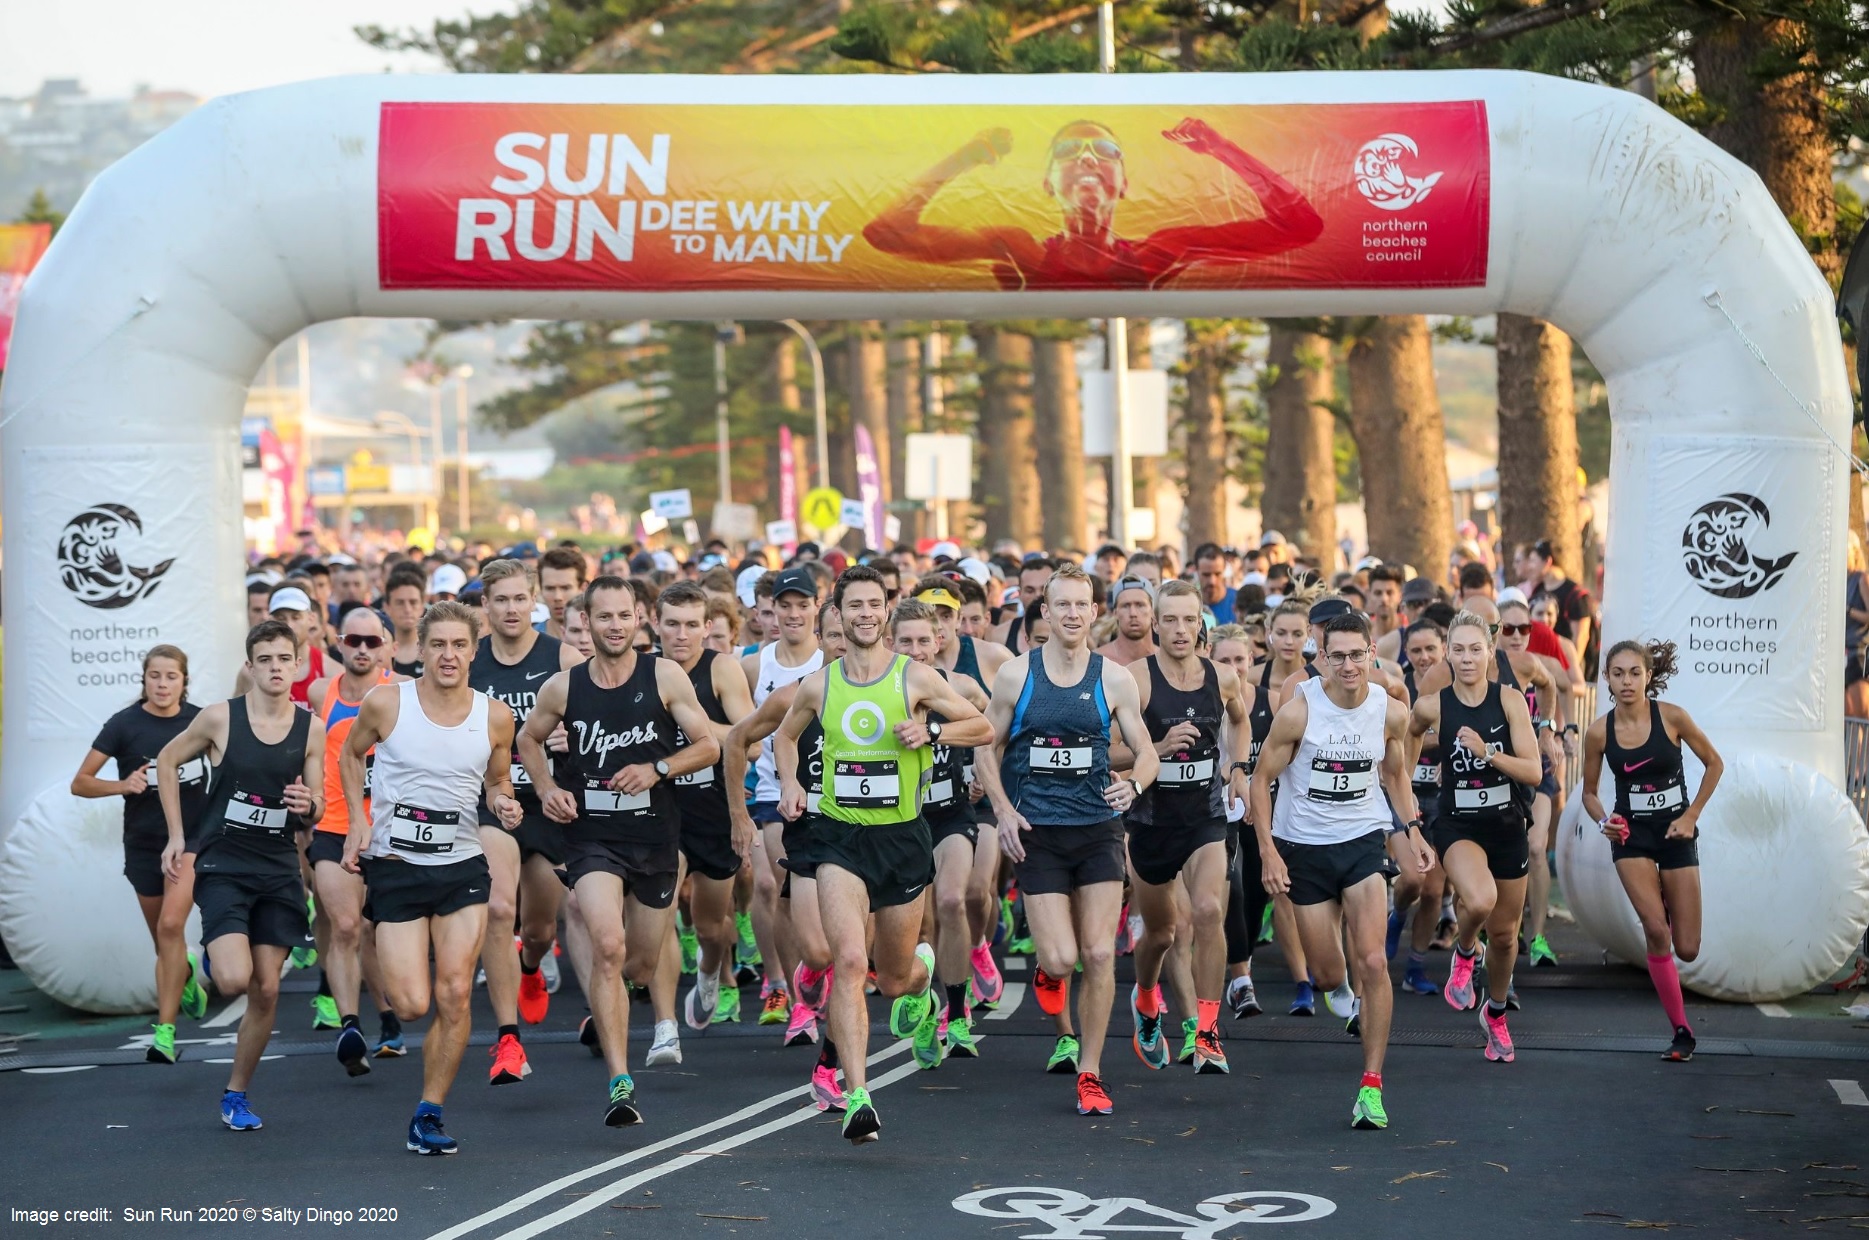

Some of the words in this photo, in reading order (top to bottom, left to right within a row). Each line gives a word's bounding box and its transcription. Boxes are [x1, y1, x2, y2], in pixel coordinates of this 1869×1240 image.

[491, 131, 670, 196] SUN
[640, 201, 716, 231] DEE
[728, 201, 831, 232] WHY
[1362, 218, 1428, 231] northern
[455, 199, 636, 261] RUN
[671, 234, 706, 253] TO
[713, 234, 854, 263] MANLY
[1362, 234, 1427, 247] beaches
[1366, 249, 1422, 261] council
[1690, 612, 1778, 630] northern
[70, 623, 159, 640] northern
[1689, 633, 1777, 653] beaches
[71, 646, 147, 664] beache
[1694, 658, 1770, 675] council
[77, 672, 142, 686] counc
[572, 720, 658, 768] Vipers
[1329, 734, 1363, 745] L.A.D.
[1050, 750, 1071, 767] 43
[1179, 764, 1195, 780] 10
[1419, 767, 1436, 781] 35
[860, 778, 870, 796] 6
[1333, 775, 1349, 790] 13
[611, 792, 621, 809] 7
[1478, 790, 1488, 806] 9
[1647, 793, 1666, 808] 49
[248, 809, 267, 825] 41
[415, 824, 432, 842] 16
